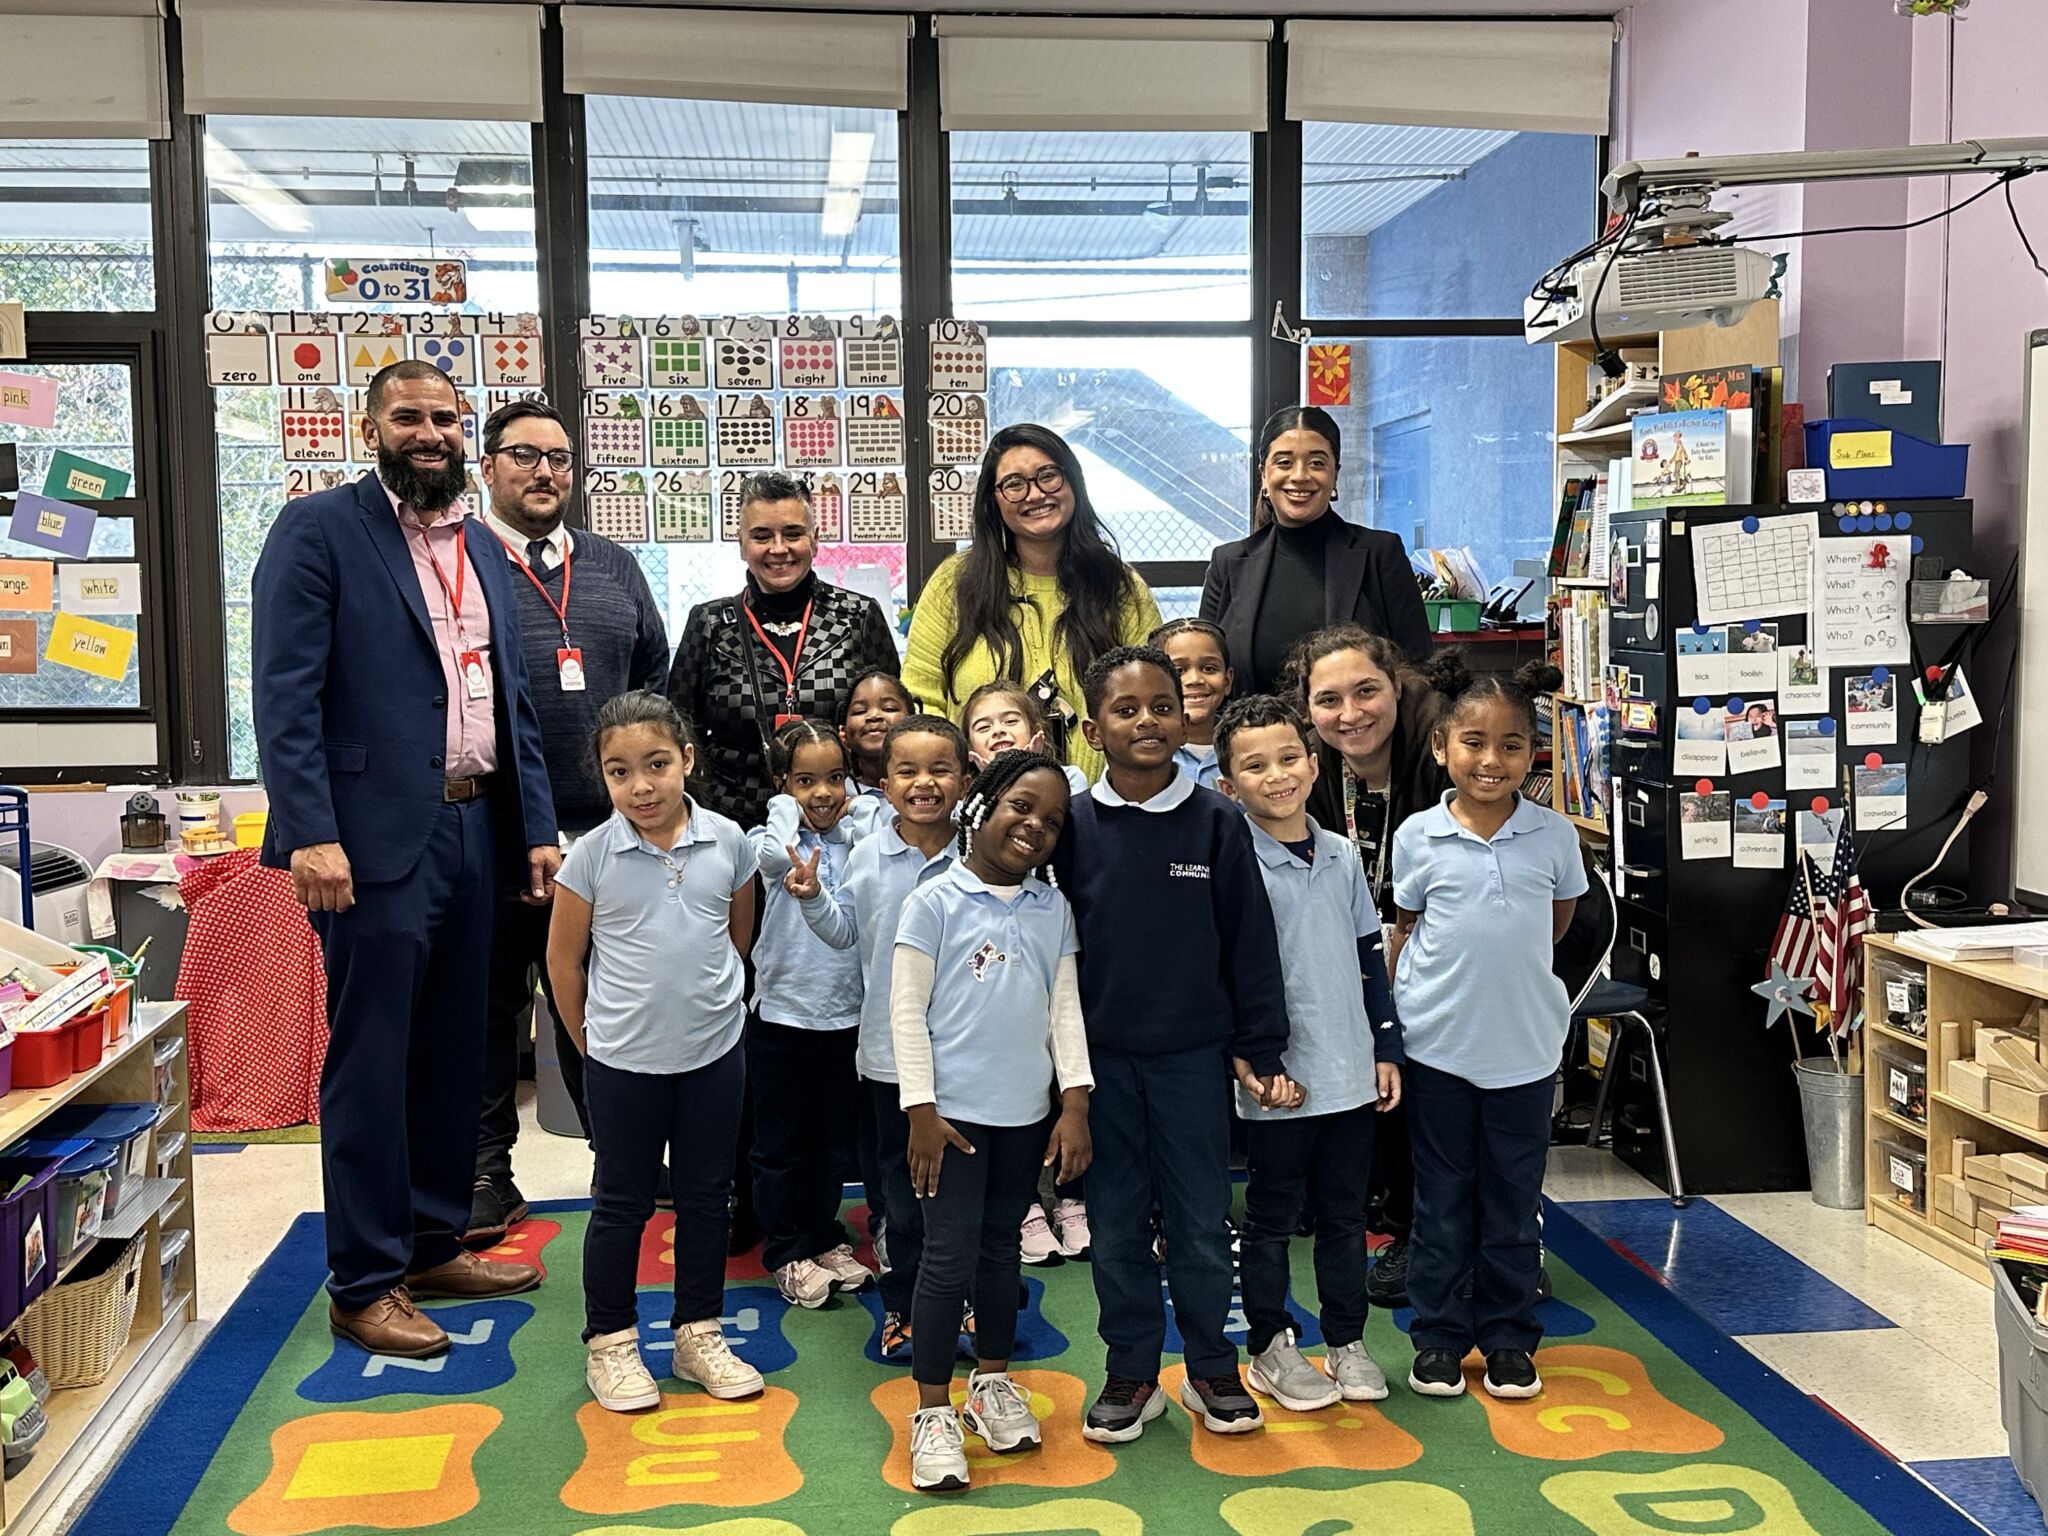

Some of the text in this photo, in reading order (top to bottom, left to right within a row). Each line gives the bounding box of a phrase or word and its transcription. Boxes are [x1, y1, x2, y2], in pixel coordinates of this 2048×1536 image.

[362, 262, 429, 276] Counting
[359, 278, 431, 300] 0 to 31
[212, 310, 234, 332] 0
[290, 310, 296, 332] 1
[354, 312, 369, 333] 2
[420, 312, 434, 333] 3
[488, 312, 504, 334] 4
[590, 314, 606, 336] 5
[656, 314, 670, 336] 6
[722, 315, 737, 336] 7
[786, 315, 800, 336] 8
[850, 314, 864, 336] 9
[936, 320, 958, 341] 10
[222, 372, 257, 382] zero
[298, 373, 321, 382] one
[500, 373, 527, 384] four
[602, 374, 626, 384] five
[668, 373, 690, 384] six
[728, 377, 762, 386] seven
[794, 374, 826, 384] eight
[860, 372, 888, 384] nine
[1702, 370, 1745, 384] Leaf Man
[950, 378, 968, 388] ten
[4, 391, 29, 406] pink
[288, 387, 304, 409] 11
[488, 390, 510, 412] 14
[587, 393, 609, 416] 15
[650, 394, 672, 416] 16
[718, 394, 740, 416] 17
[786, 396, 810, 417] 18
[850, 395, 870, 416] 19
[933, 395, 962, 416] 20
[294, 448, 335, 458] eleven
[942, 454, 978, 463] twenty
[596, 454, 636, 464] fifteen
[661, 456, 699, 465] sixteen
[725, 456, 769, 464] seventeen
[795, 456, 833, 465] eighteen
[854, 456, 896, 464] nineteen
[70, 476, 102, 493] green
[290, 470, 312, 492] 21
[590, 471, 618, 492] 25
[654, 471, 682, 492] 26
[850, 472, 876, 494] 29
[932, 470, 962, 492] 30
[41, 511, 62, 530] blue
[600, 532, 644, 540] enty-five
[664, 533, 704, 541] twenty-six
[854, 532, 902, 540] twenty-nine
[1826, 554, 1862, 564] Where?
[84, 579, 118, 594] white
[1826, 580, 1856, 590] What?
[1826, 605, 1860, 614] Which?
[1826, 630, 1853, 640] Who?
[73, 636, 106, 655] yellow
[1695, 672, 1710, 680] trick
[1740, 669, 1763, 678] foolish
[1785, 691, 1822, 699] character
[1851, 722, 1892, 730] community
[1682, 752, 1718, 762] disappear
[1740, 748, 1768, 758] believe
[1802, 767, 1820, 776] leap
[1864, 809, 1896, 817] crowded
[1694, 836, 1718, 846] setting
[1740, 845, 1778, 853] adventure
[1170, 862, 1184, 871] THE
